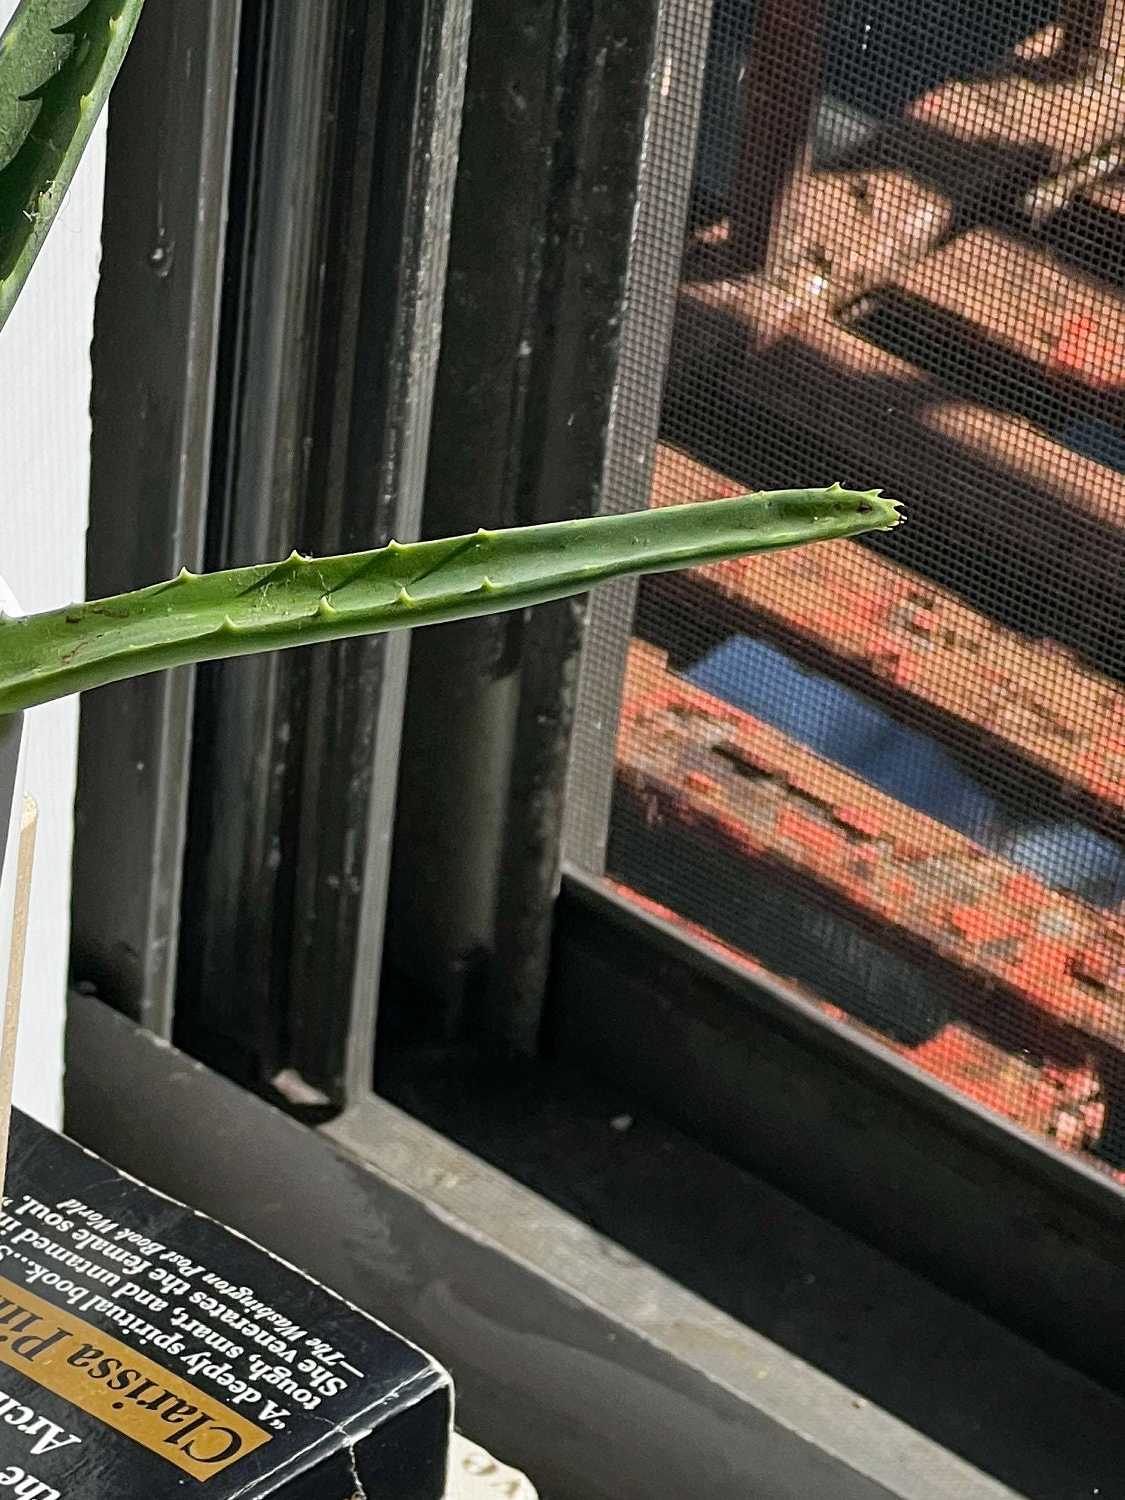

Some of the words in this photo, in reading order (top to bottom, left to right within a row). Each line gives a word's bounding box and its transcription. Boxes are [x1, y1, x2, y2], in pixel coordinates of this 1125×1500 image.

[56, 1198, 120, 1234] World
[10, 1228, 121, 1287] untamed
[71, 1228, 152, 1275] female
[114, 1228, 167, 1256] Book
[159, 1250, 206, 1277] Post
[111, 1281, 169, 1311] and
[148, 1267, 191, 1295] the
[79, 1295, 186, 1355] spiritual
[171, 1307, 244, 1358] smart,
[188, 1291, 297, 1363] venerates
[201, 1272, 308, 1342] Washington
[180, 1351, 262, 1404] deeply
[249, 1354, 321, 1410] tough,
[297, 1358, 348, 1396] She
[65, 1342, 244, 1464] Clarissa
